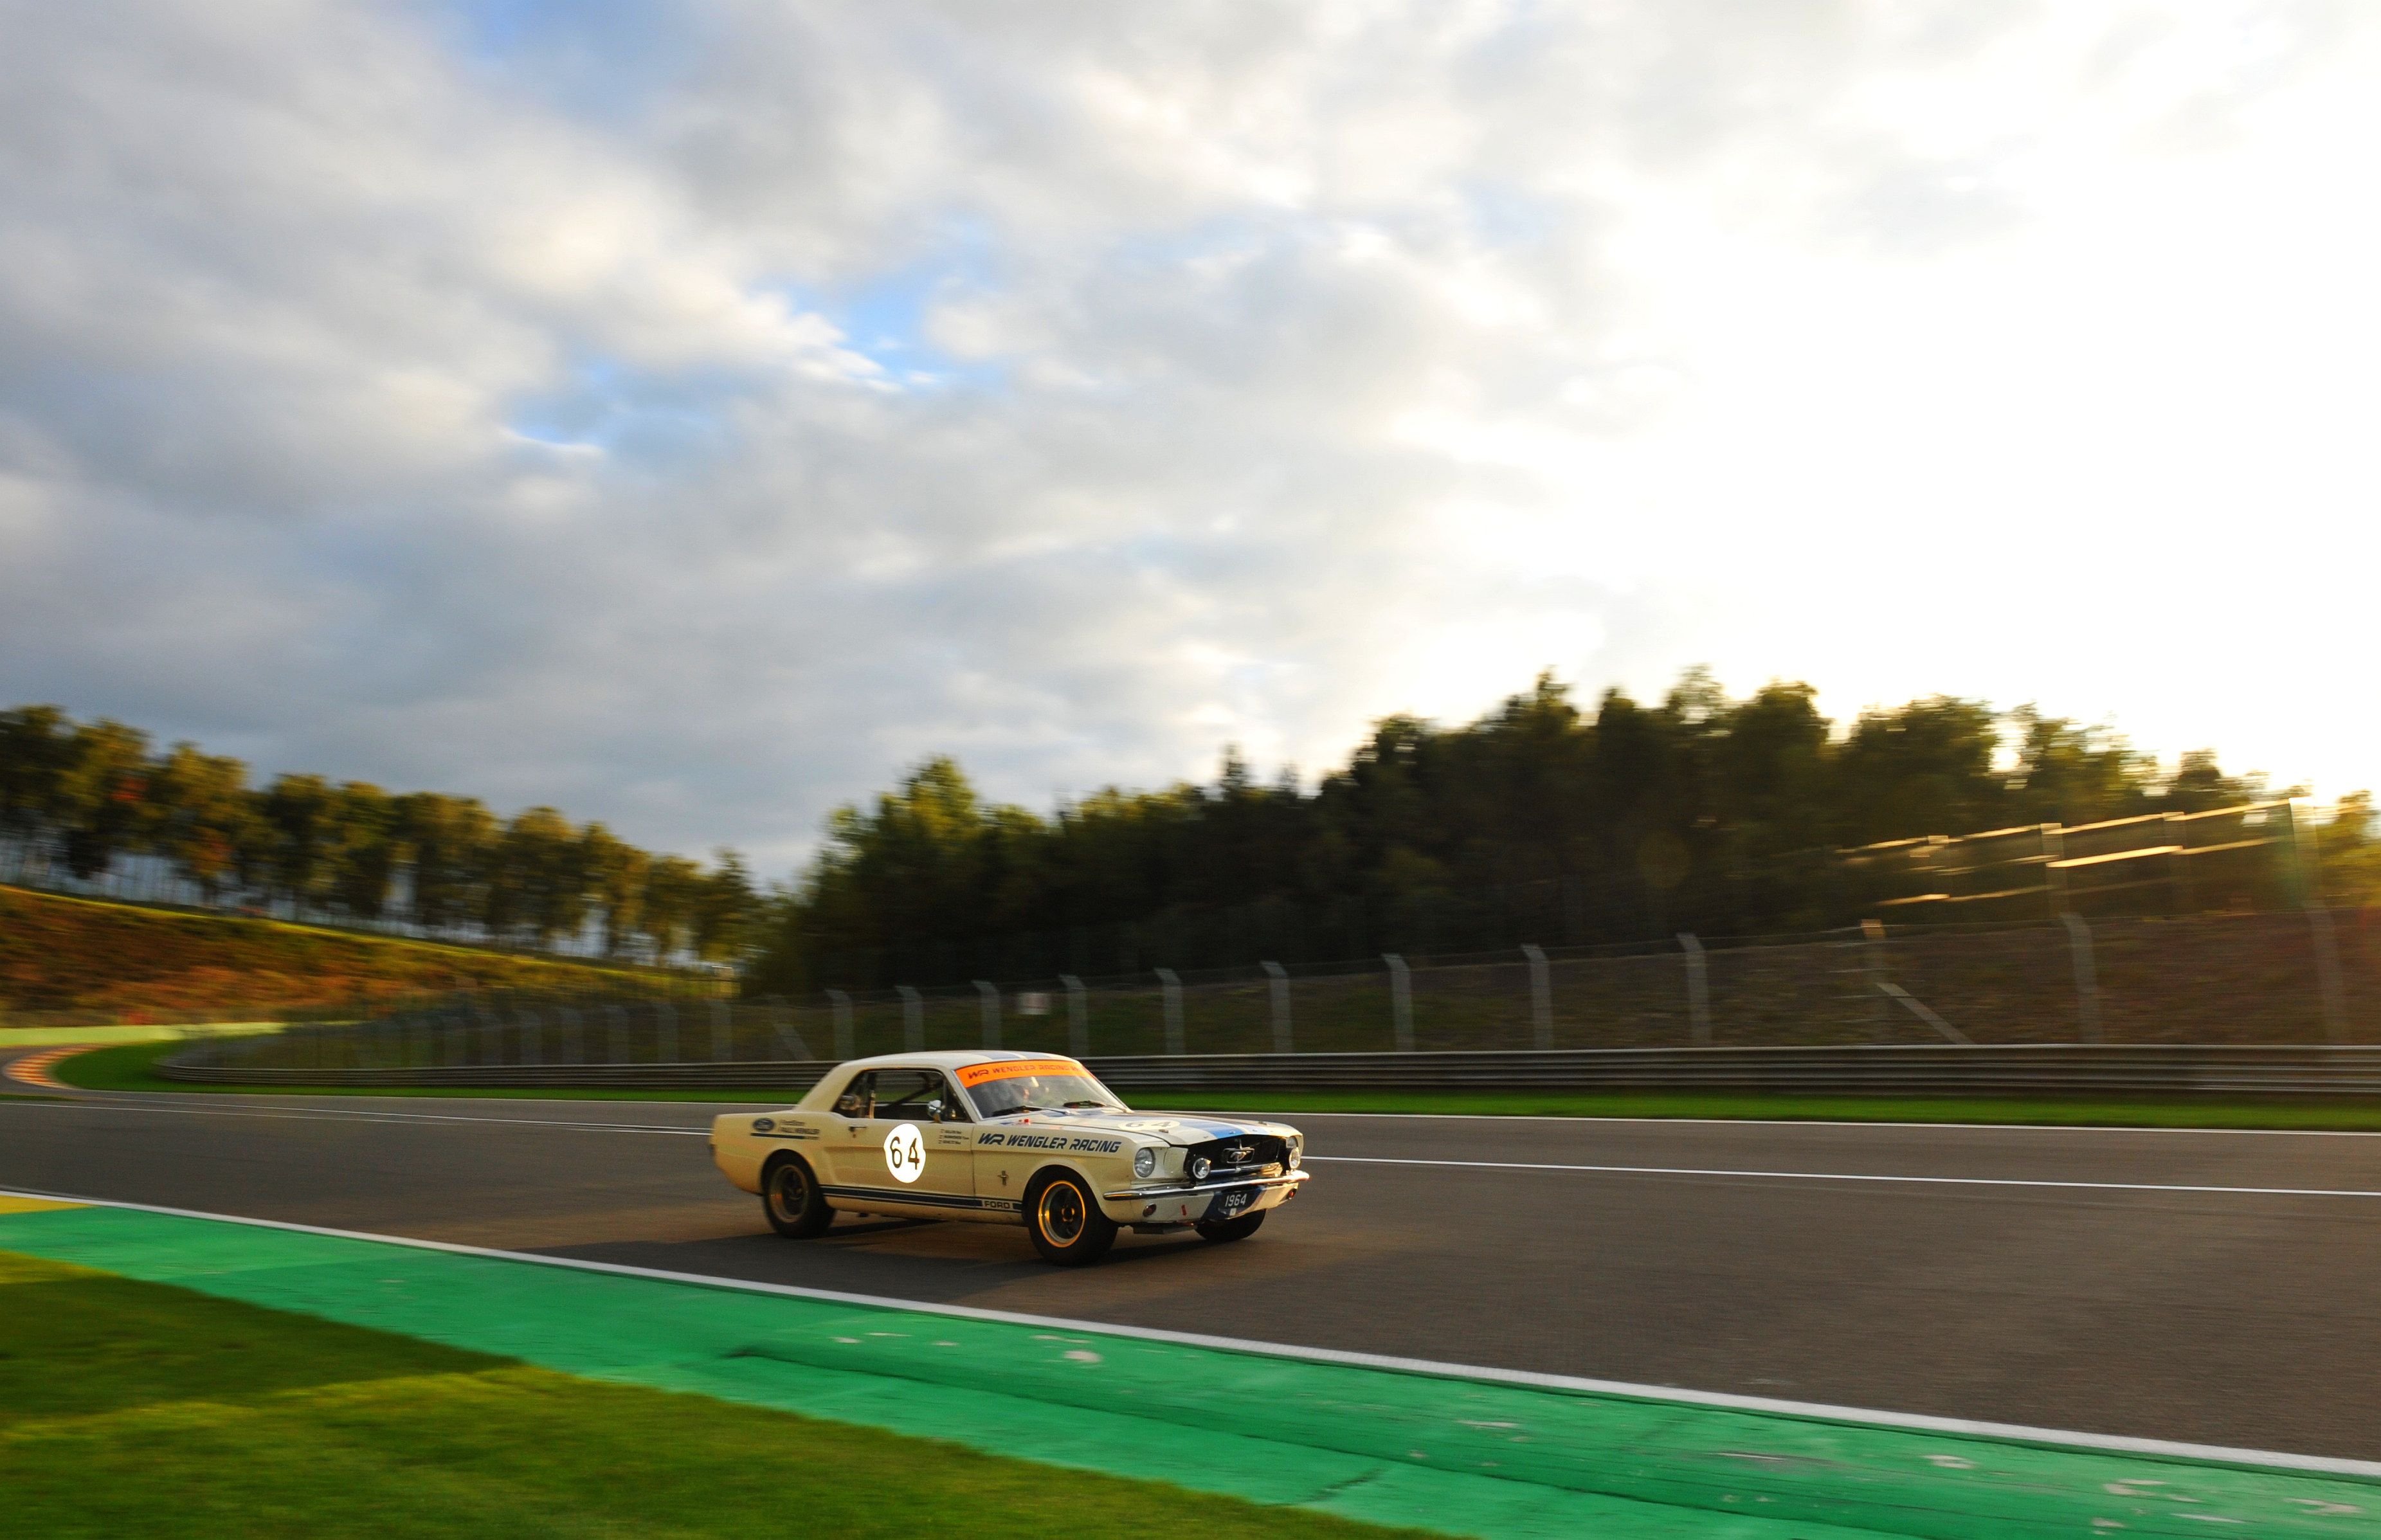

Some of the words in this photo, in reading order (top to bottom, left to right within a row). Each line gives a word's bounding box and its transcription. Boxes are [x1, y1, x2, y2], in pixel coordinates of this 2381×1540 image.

[992, 1064, 1037, 1073] WENGLER
[977, 1133, 1005, 1146] WR
[1006, 1134, 1067, 1150] WENGLER
[1069, 1138, 1122, 1153] RACING
[890, 1136, 919, 1170] 64
[984, 1200, 1010, 1209] FORD
[1225, 1193, 1247, 1207] 1964
